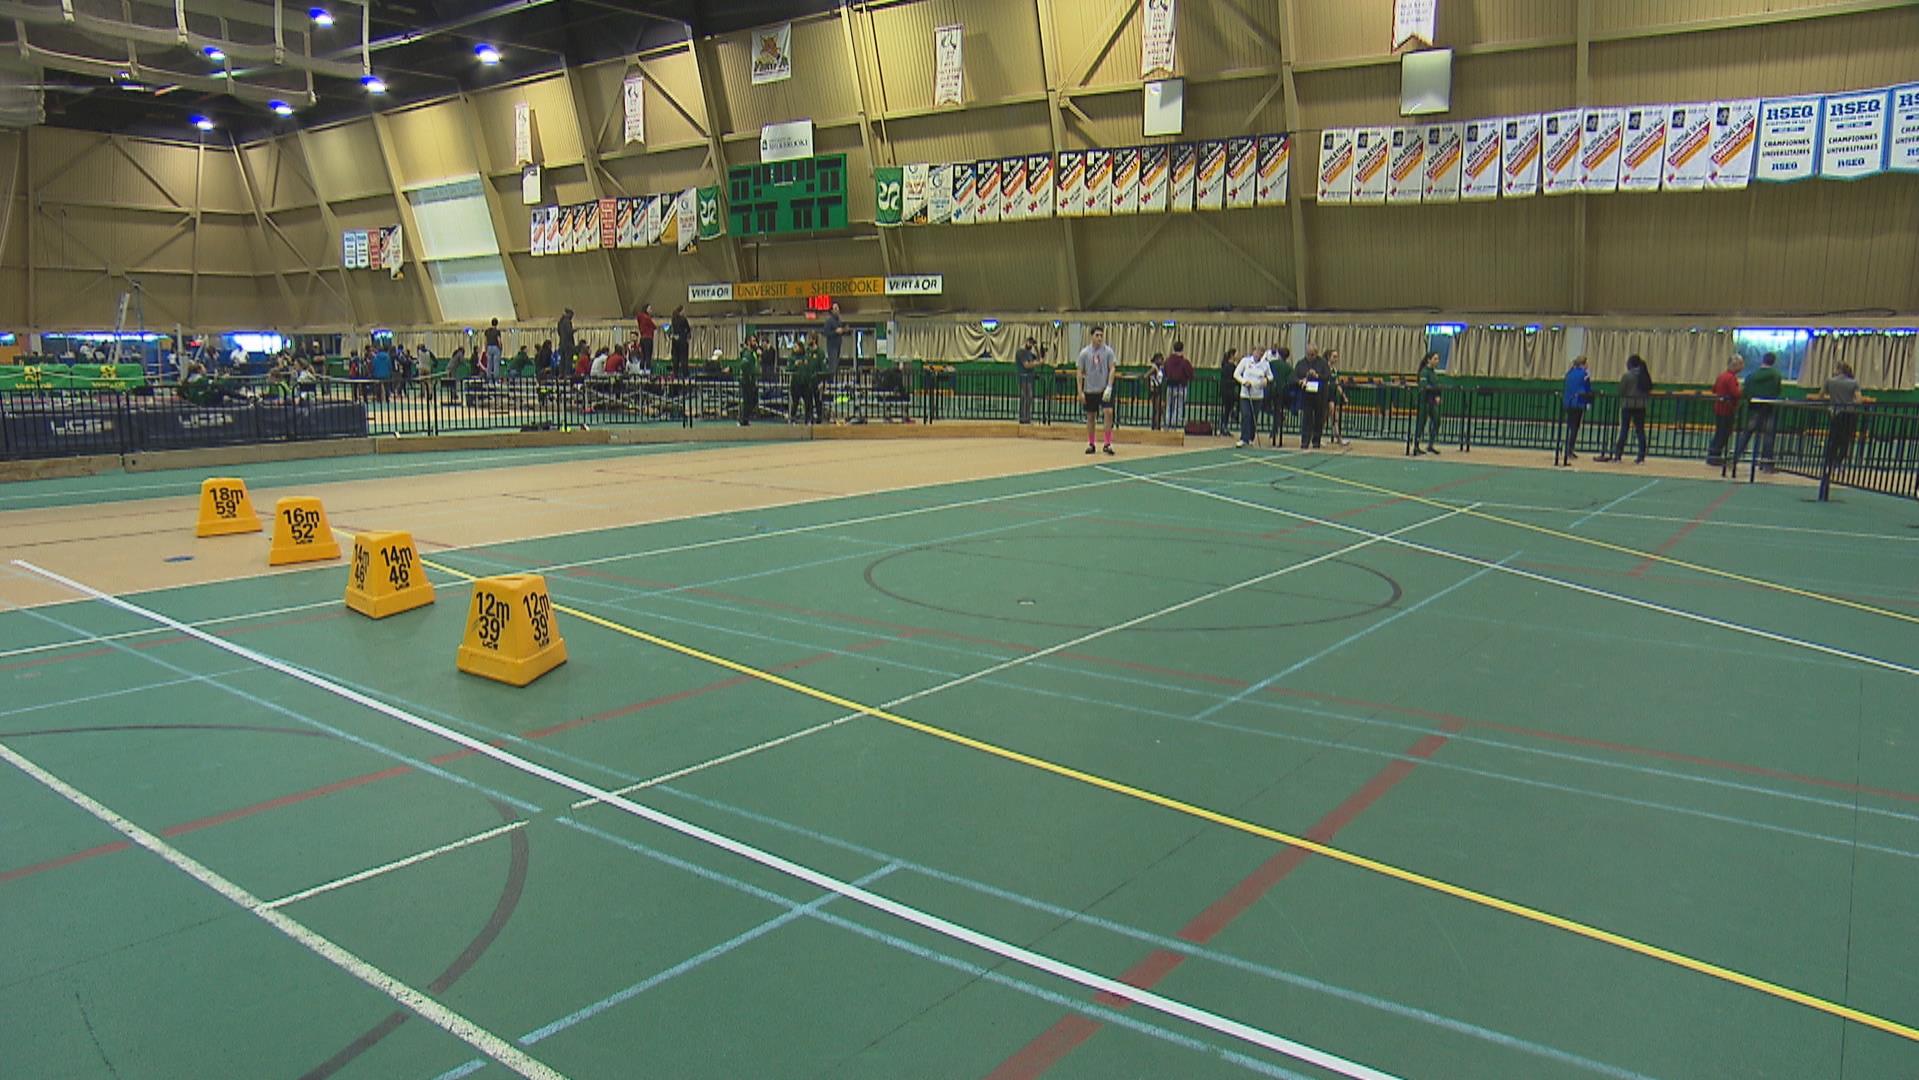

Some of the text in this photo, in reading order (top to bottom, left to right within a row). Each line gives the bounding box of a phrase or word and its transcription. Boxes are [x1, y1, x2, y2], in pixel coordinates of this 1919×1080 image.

[1766, 104, 1814, 121] RSEQ
[1830, 99, 1881, 116] RSEQ
[1764, 138, 1810, 147] CHAMPIONNES
[1828, 133, 1878, 144] CHAMPIONNES
[1762, 148, 1810, 158] UNIVERSITAIRES
[1826, 144, 1878, 155] UNIVERSITAIRES
[811, 279, 878, 294] SHERBROOKE
[209, 487, 244, 502] 18m
[283, 508, 320, 525] 16m
[354, 544, 370, 566] 14m
[380, 545, 413, 567] 14m
[476, 591, 510, 621] 12m
[523, 591, 550, 618] 12m
